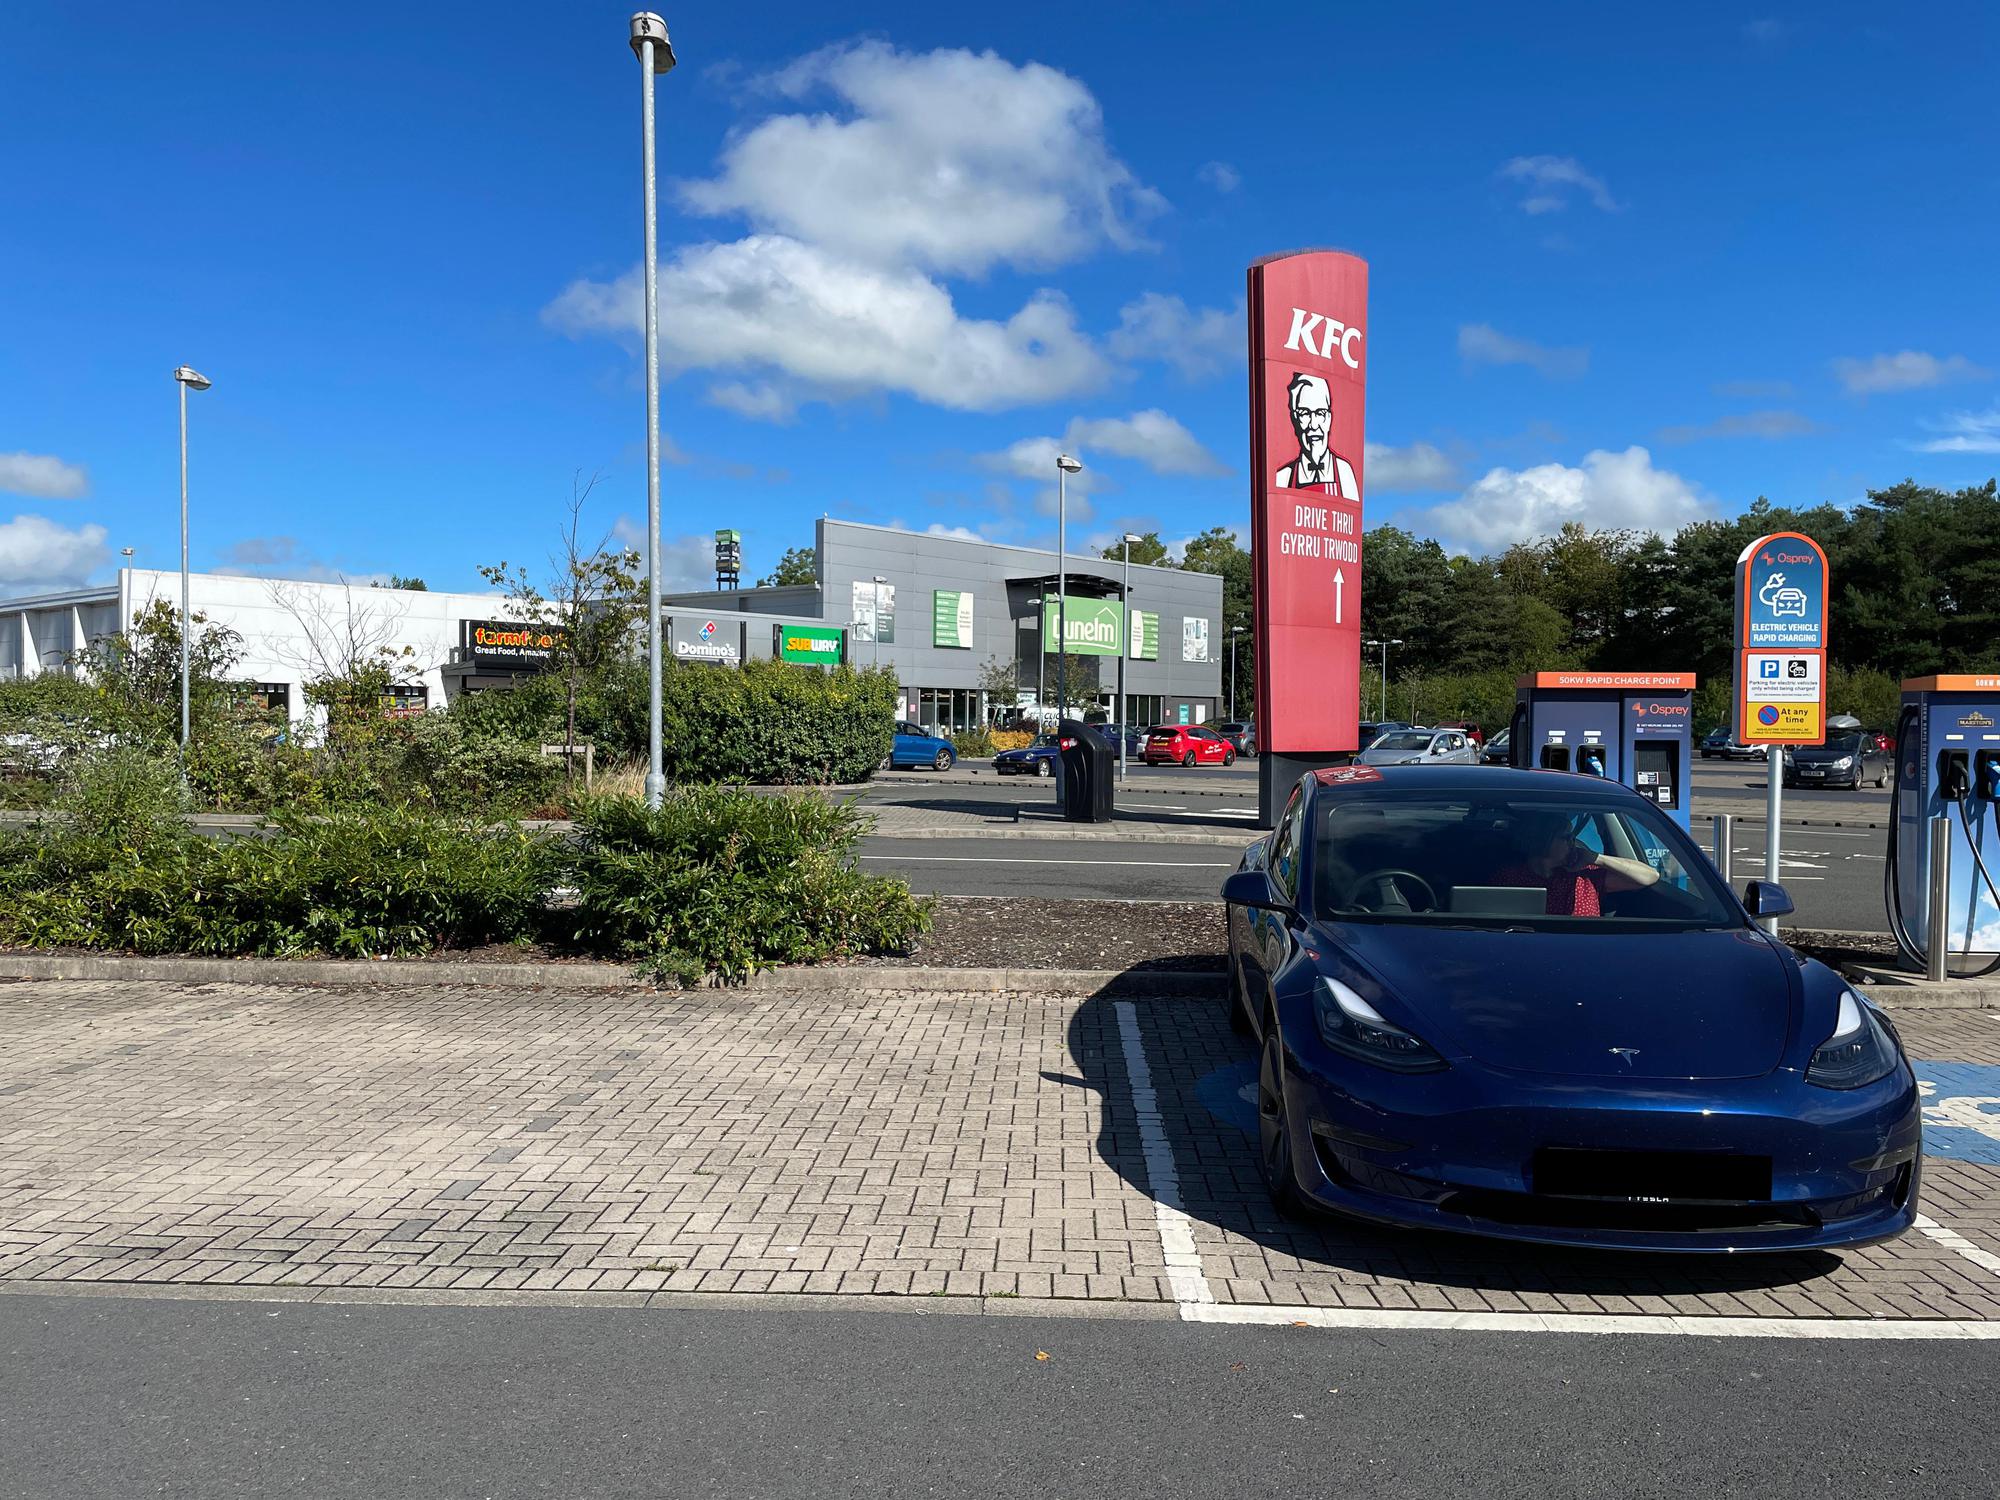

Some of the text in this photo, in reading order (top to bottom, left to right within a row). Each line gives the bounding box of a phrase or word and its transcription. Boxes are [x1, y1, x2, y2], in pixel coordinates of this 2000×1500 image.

[1283, 306, 1363, 369] KFC
[1295, 505, 1354, 535] DRIVE THRU
[1280, 532, 1358, 564] GYRRU TRWODD
[1777, 552, 1814, 565] Osprey
[1751, 623, 1819, 631] ELECTRIC VEHICLE
[786, 637, 839, 652] SUBWAY
[1753, 634, 1816, 642] RAPID CHARGING
[475, 646, 497, 654] Great
[497, 646, 518, 656] Food,
[678, 641, 736, 657] Domino's
[1559, 676, 1681, 685] 50KW RAPID CHARGE POINT
[1649, 703, 1689, 717] Osprey
[1793, 709, 1808, 717] any
